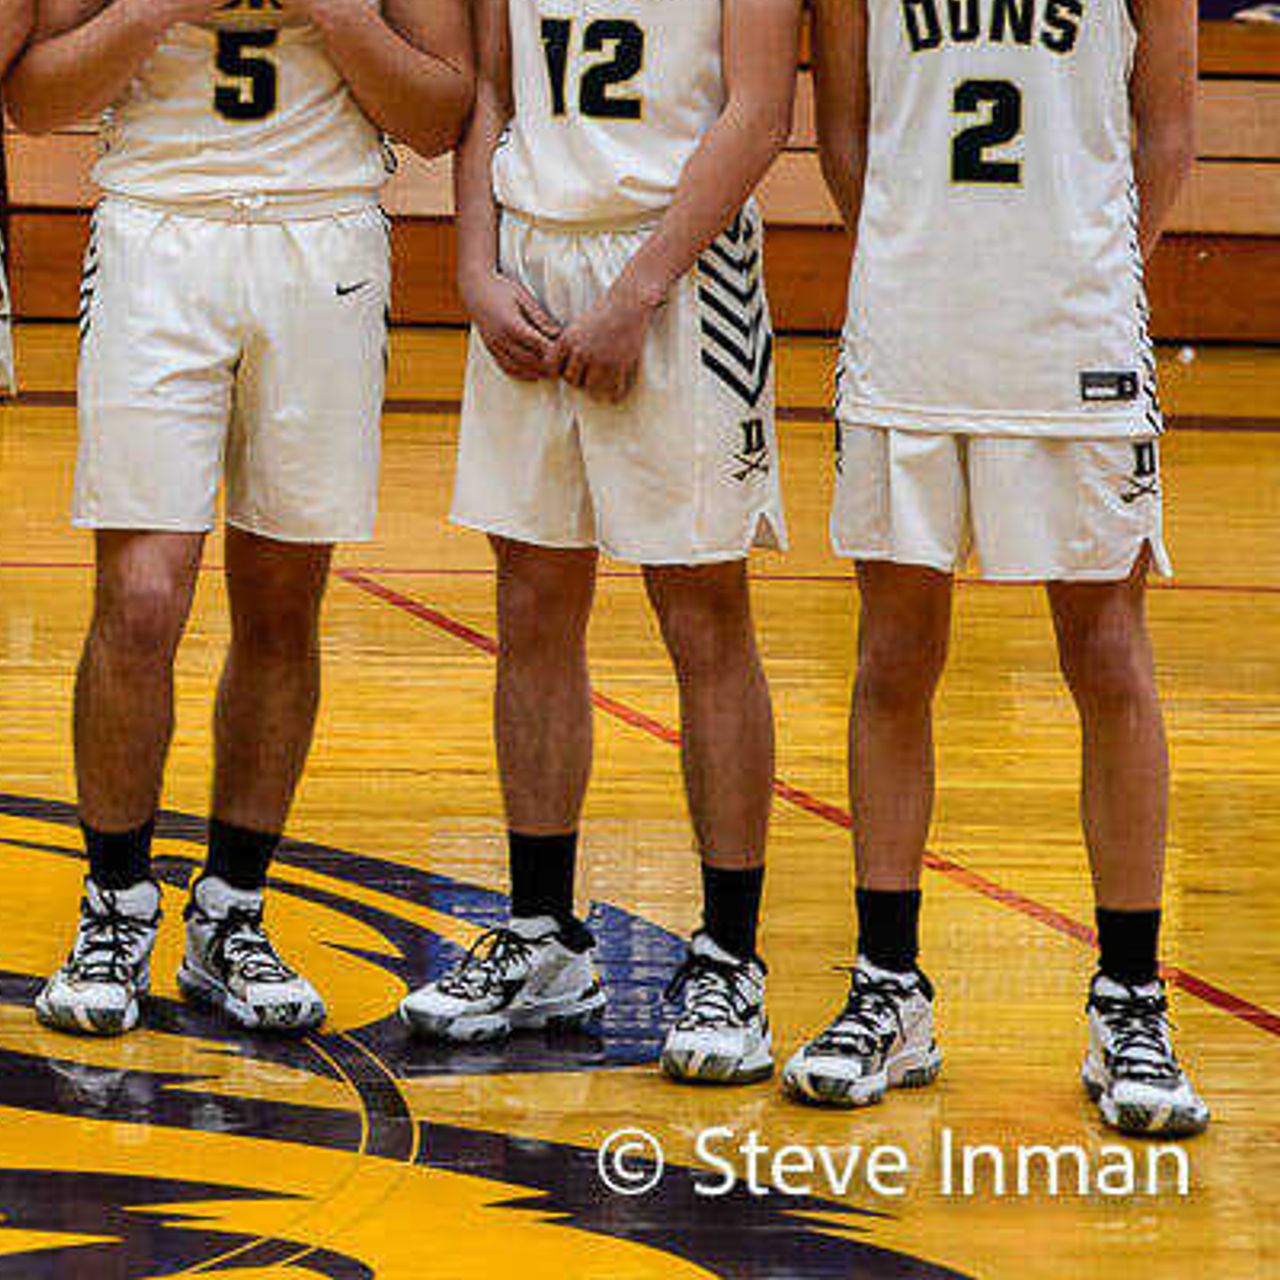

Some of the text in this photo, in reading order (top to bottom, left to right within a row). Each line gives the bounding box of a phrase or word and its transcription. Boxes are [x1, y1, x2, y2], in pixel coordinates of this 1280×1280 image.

[212, 28, 281, 125] 5
[540, 16, 645, 123] 12
[948, 77, 1025, 187] 2
